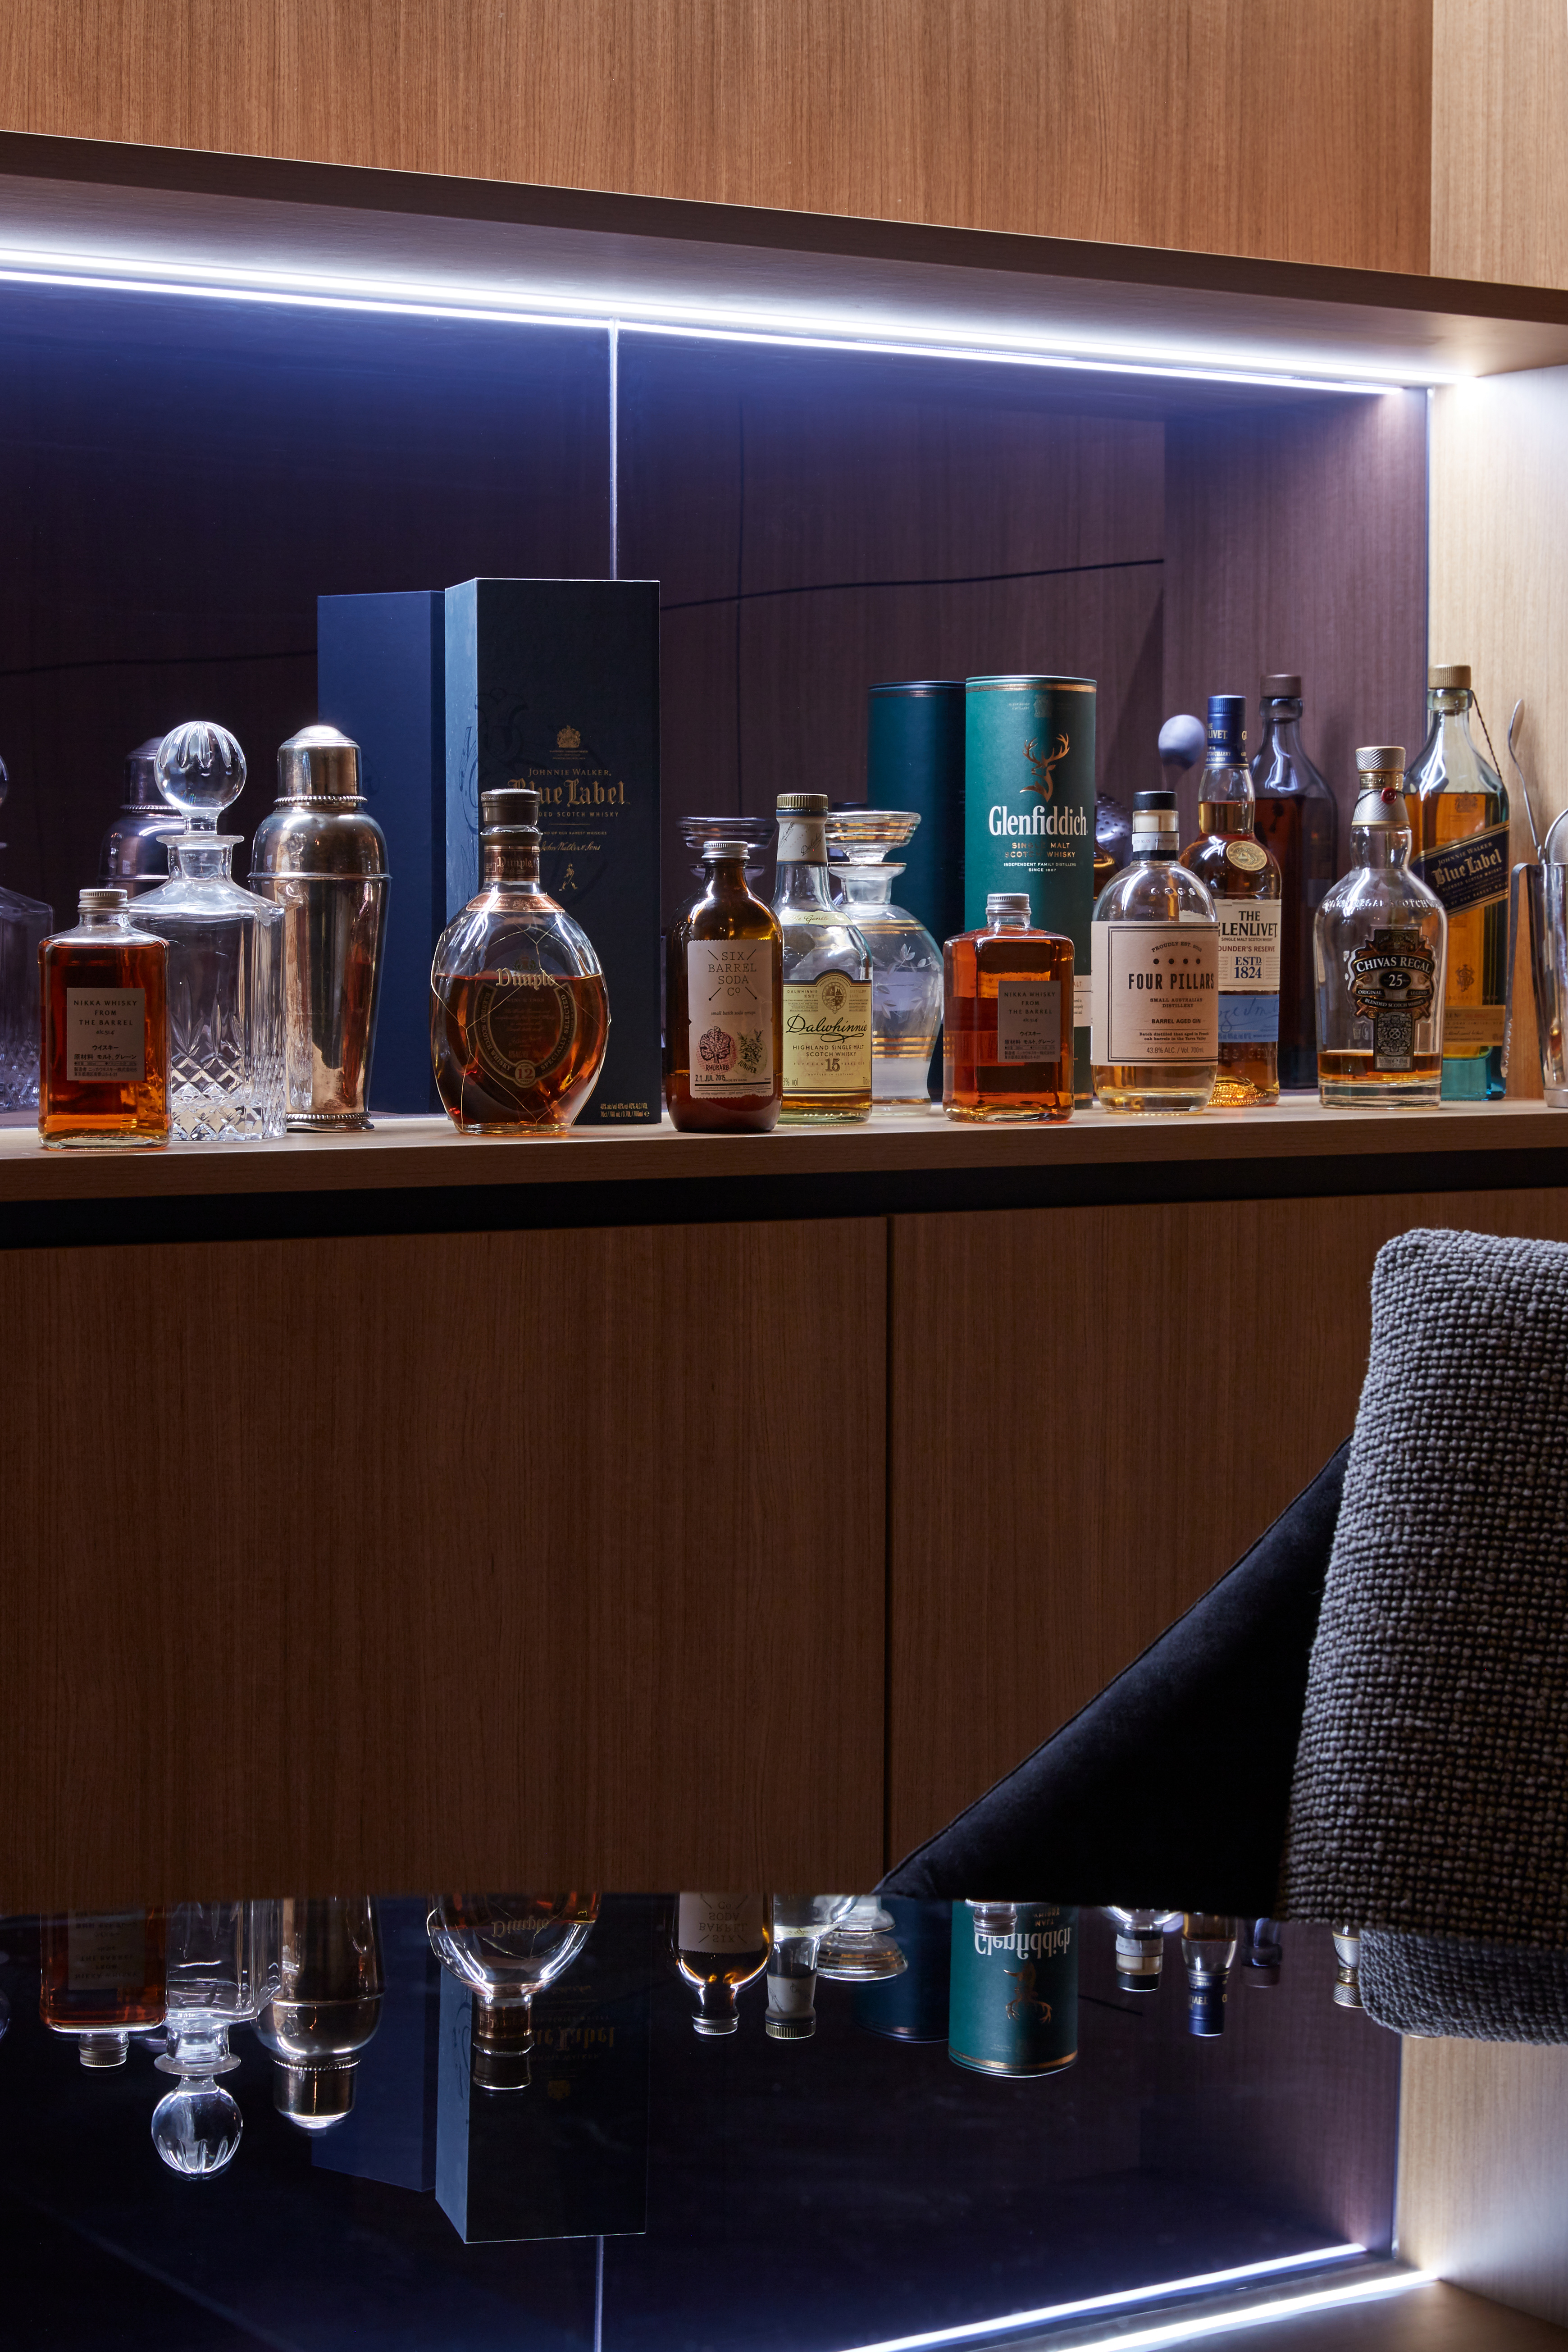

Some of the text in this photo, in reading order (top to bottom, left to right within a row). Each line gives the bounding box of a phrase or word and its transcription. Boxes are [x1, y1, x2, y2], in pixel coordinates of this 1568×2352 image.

[528, 768, 569, 777] JOHNNIE
[564, 778, 626, 807] Label
[989, 805, 1087, 836] Glenfiddich
[1467, 842, 1493, 854] WALKER
[1431, 865, 1466, 888] Blue
[1464, 848, 1502, 876] Label
[1238, 911, 1260, 921] THE
[1218, 922, 1278, 938] LENLIVET
[1151, 941, 1179, 953] PROUDLY
[722, 951, 745, 961] SIX
[708, 963, 757, 973] BARREL
[1234, 966, 1262, 979] 1824
[1356, 957, 1431, 974] CHIVAS REGAL
[496, 967, 555, 991] Dimple
[718, 975, 749, 985] SODA
[1129, 973, 1214, 990] FOUR PILLARS
[1389, 974, 1403, 987] 25
[1364, 998, 1387, 1007] BLENDED
[785, 1013, 868, 1033] Dalwhinnie
[540, 994, 570, 1071] SPECIALLY SELECTED
[481, 1024, 492, 1049] SCOTCH
[490, 1050, 512, 1071] WHISKY
[738, 1060, 757, 1074] JUNIPER
[825, 1058, 840, 1072] 15
[518, 1068, 533, 1079] 12
